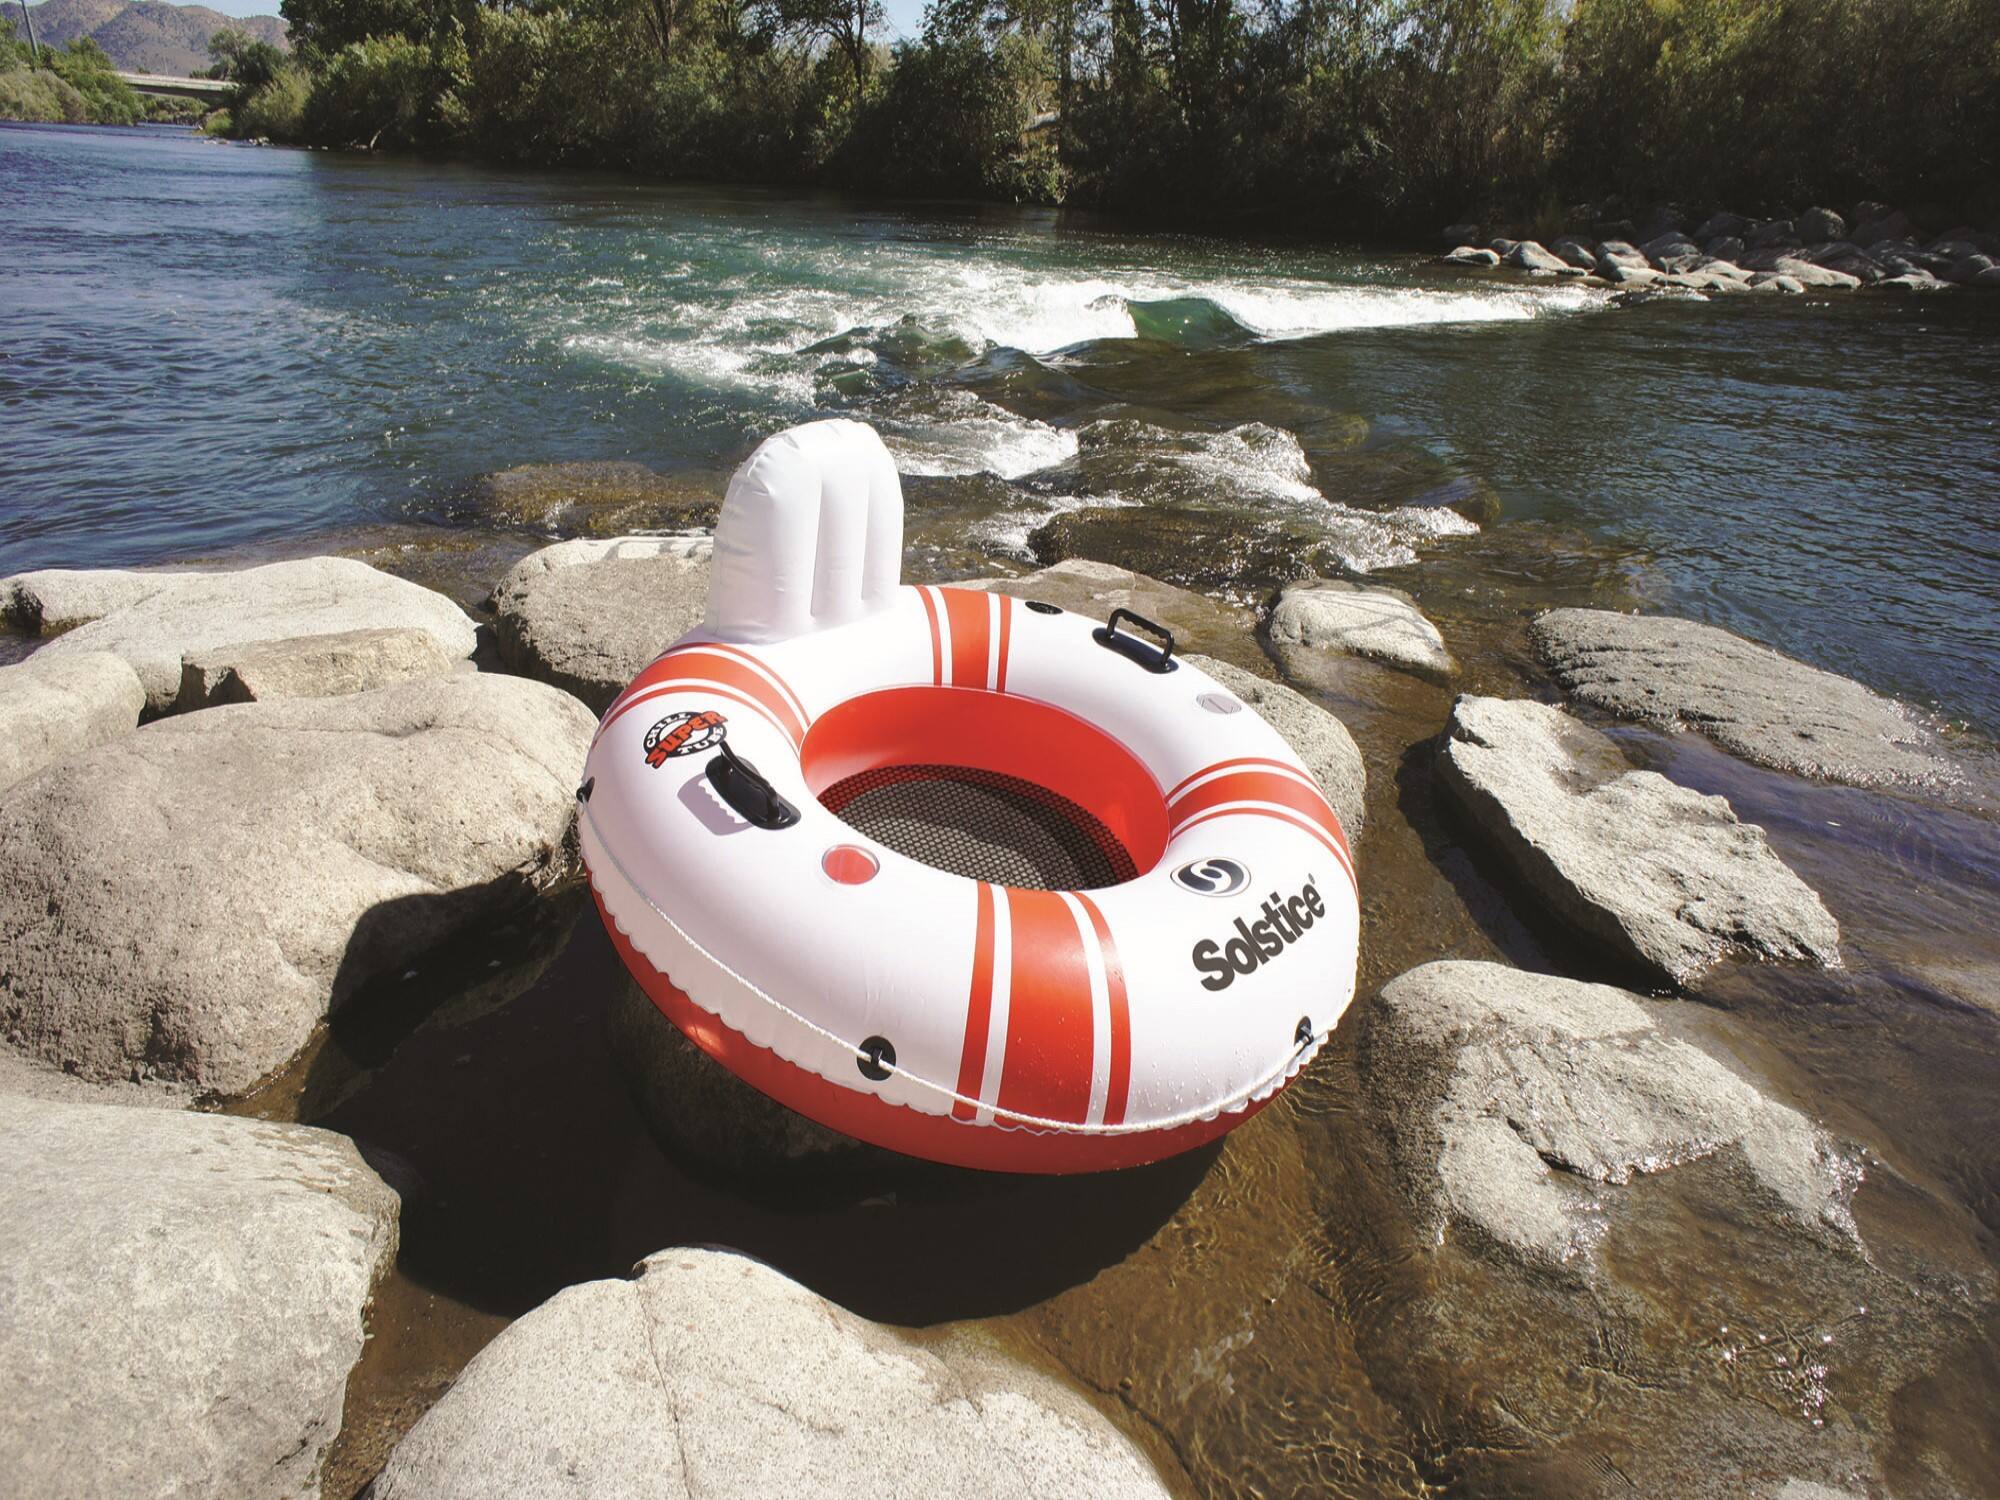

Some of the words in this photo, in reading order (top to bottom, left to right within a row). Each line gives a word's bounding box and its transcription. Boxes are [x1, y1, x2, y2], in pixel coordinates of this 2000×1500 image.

[645, 711, 728, 769] SUPER
[646, 713, 691, 748] CHILL
[677, 726, 724, 754] TUBE
[1192, 883, 1325, 991] Solstice
